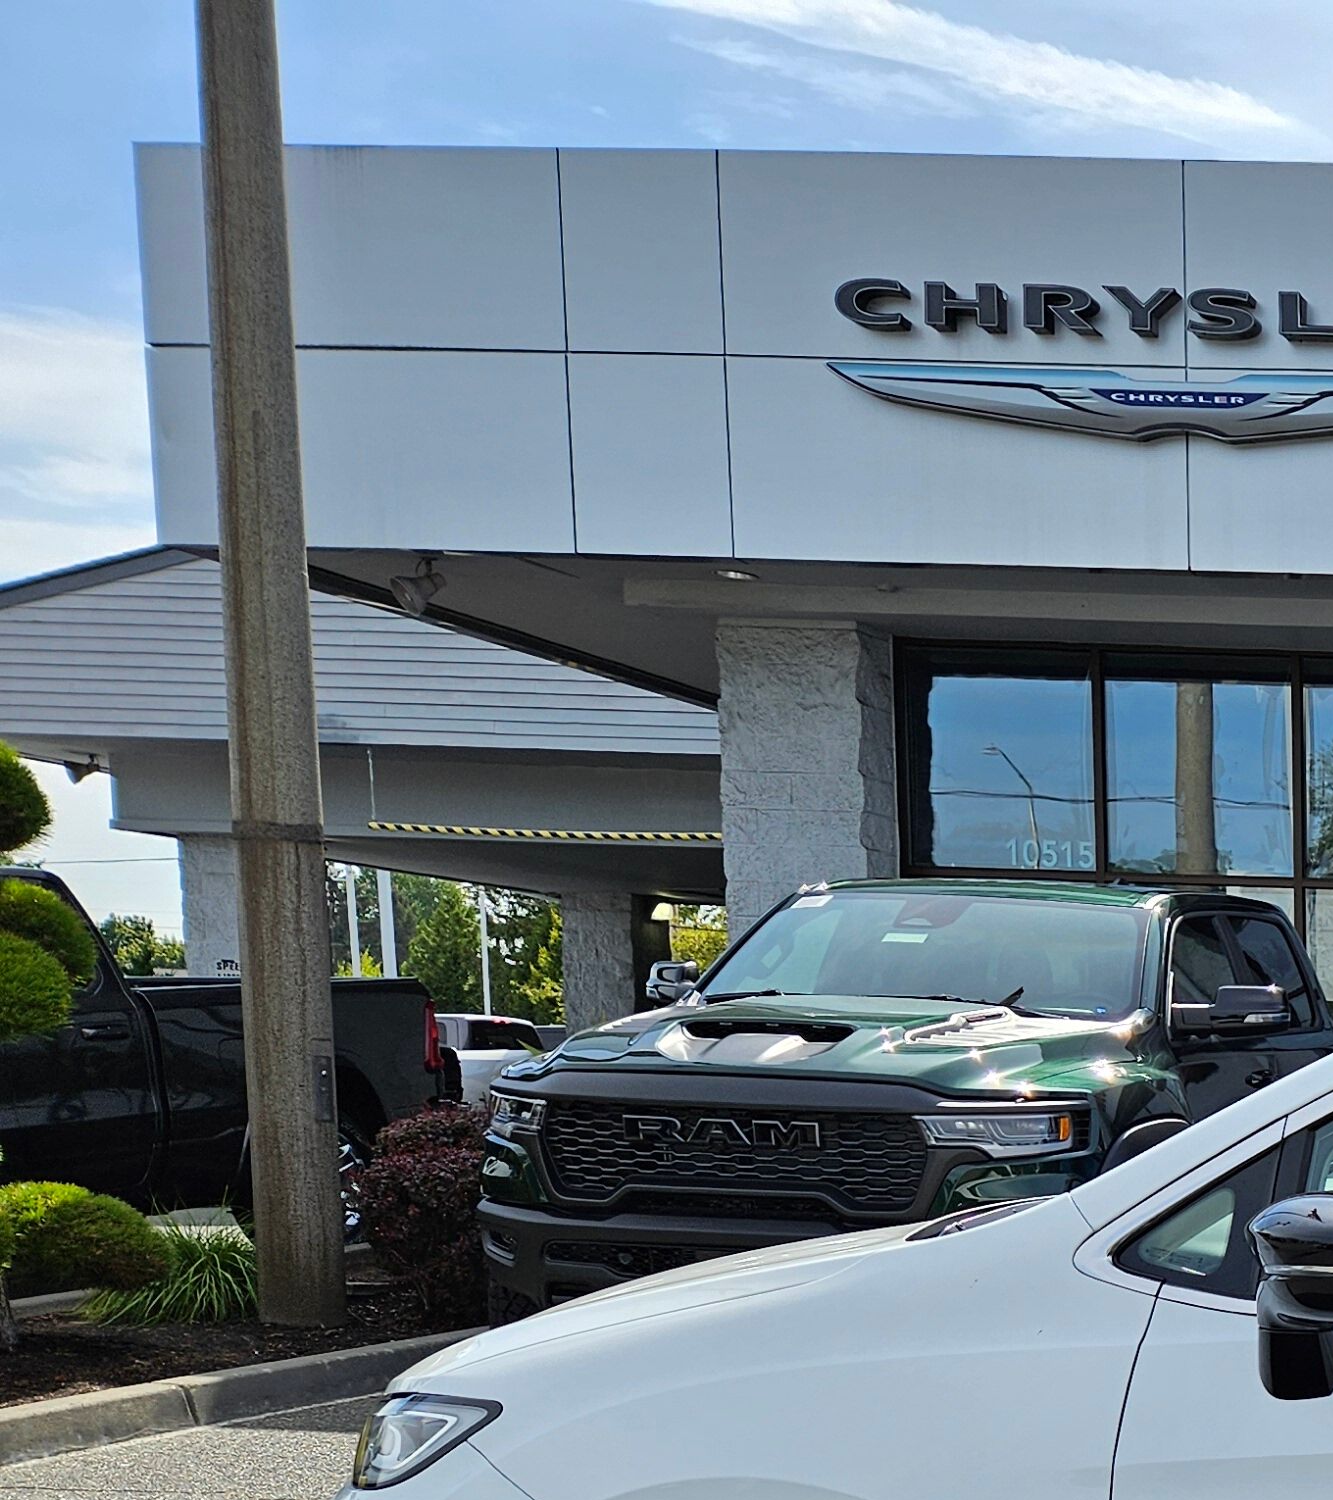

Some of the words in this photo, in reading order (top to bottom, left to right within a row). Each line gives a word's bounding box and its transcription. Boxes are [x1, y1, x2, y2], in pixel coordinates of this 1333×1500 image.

[1110, 392, 1244, 404] CHRYSLER
[1006, 837, 1094, 869] 10515
[622, 1114, 821, 1148] RAM
